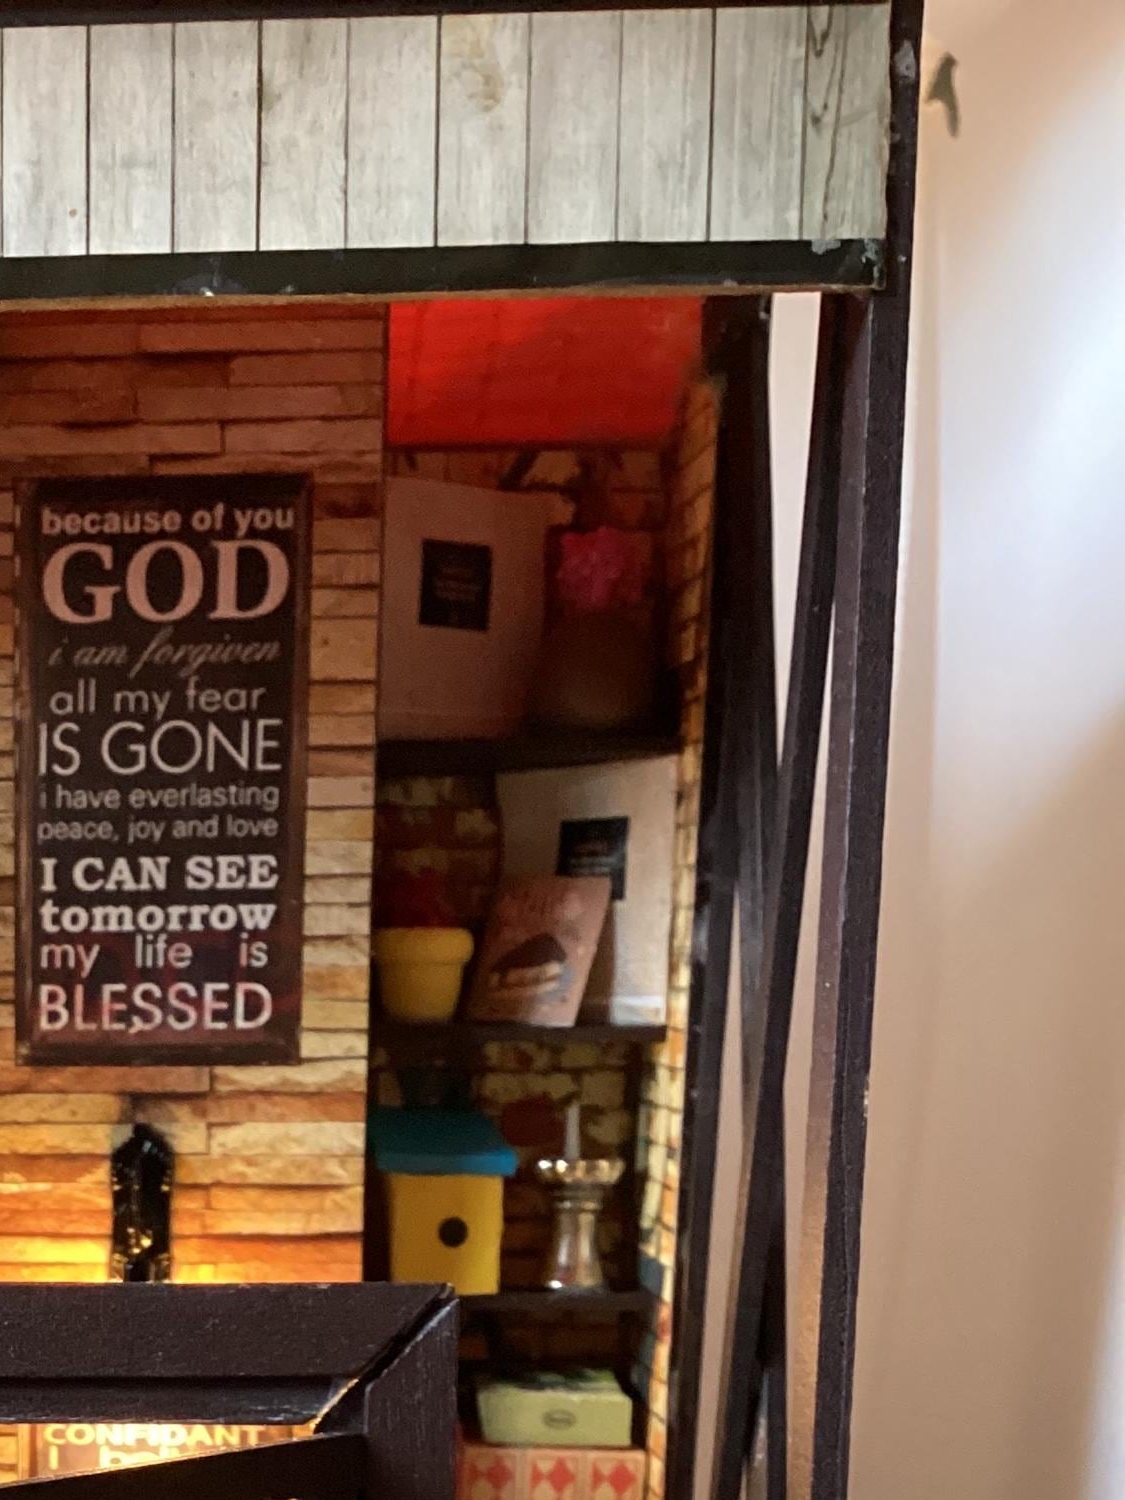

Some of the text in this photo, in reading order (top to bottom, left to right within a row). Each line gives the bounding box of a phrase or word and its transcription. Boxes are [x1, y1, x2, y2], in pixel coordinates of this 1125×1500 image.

[42, 501, 294, 539] because of you
[42, 539, 290, 624] GOD
[74, 644, 126, 666] am
[129, 625, 280, 679] forgiven
[49, 674, 266, 721] all my fear
[38, 718, 283, 776] IS GONE
[55, 783, 122, 810] have
[127, 782, 280, 812] everlasting
[36, 814, 278, 845] peace, joy and love
[39, 853, 280, 892] I CAN SEE
[39, 899, 278, 934] tomorrow
[39, 932, 269, 979] my life is
[38, 981, 274, 1032] BLESSED
[42, 1423, 267, 1446] CONFIDANT
